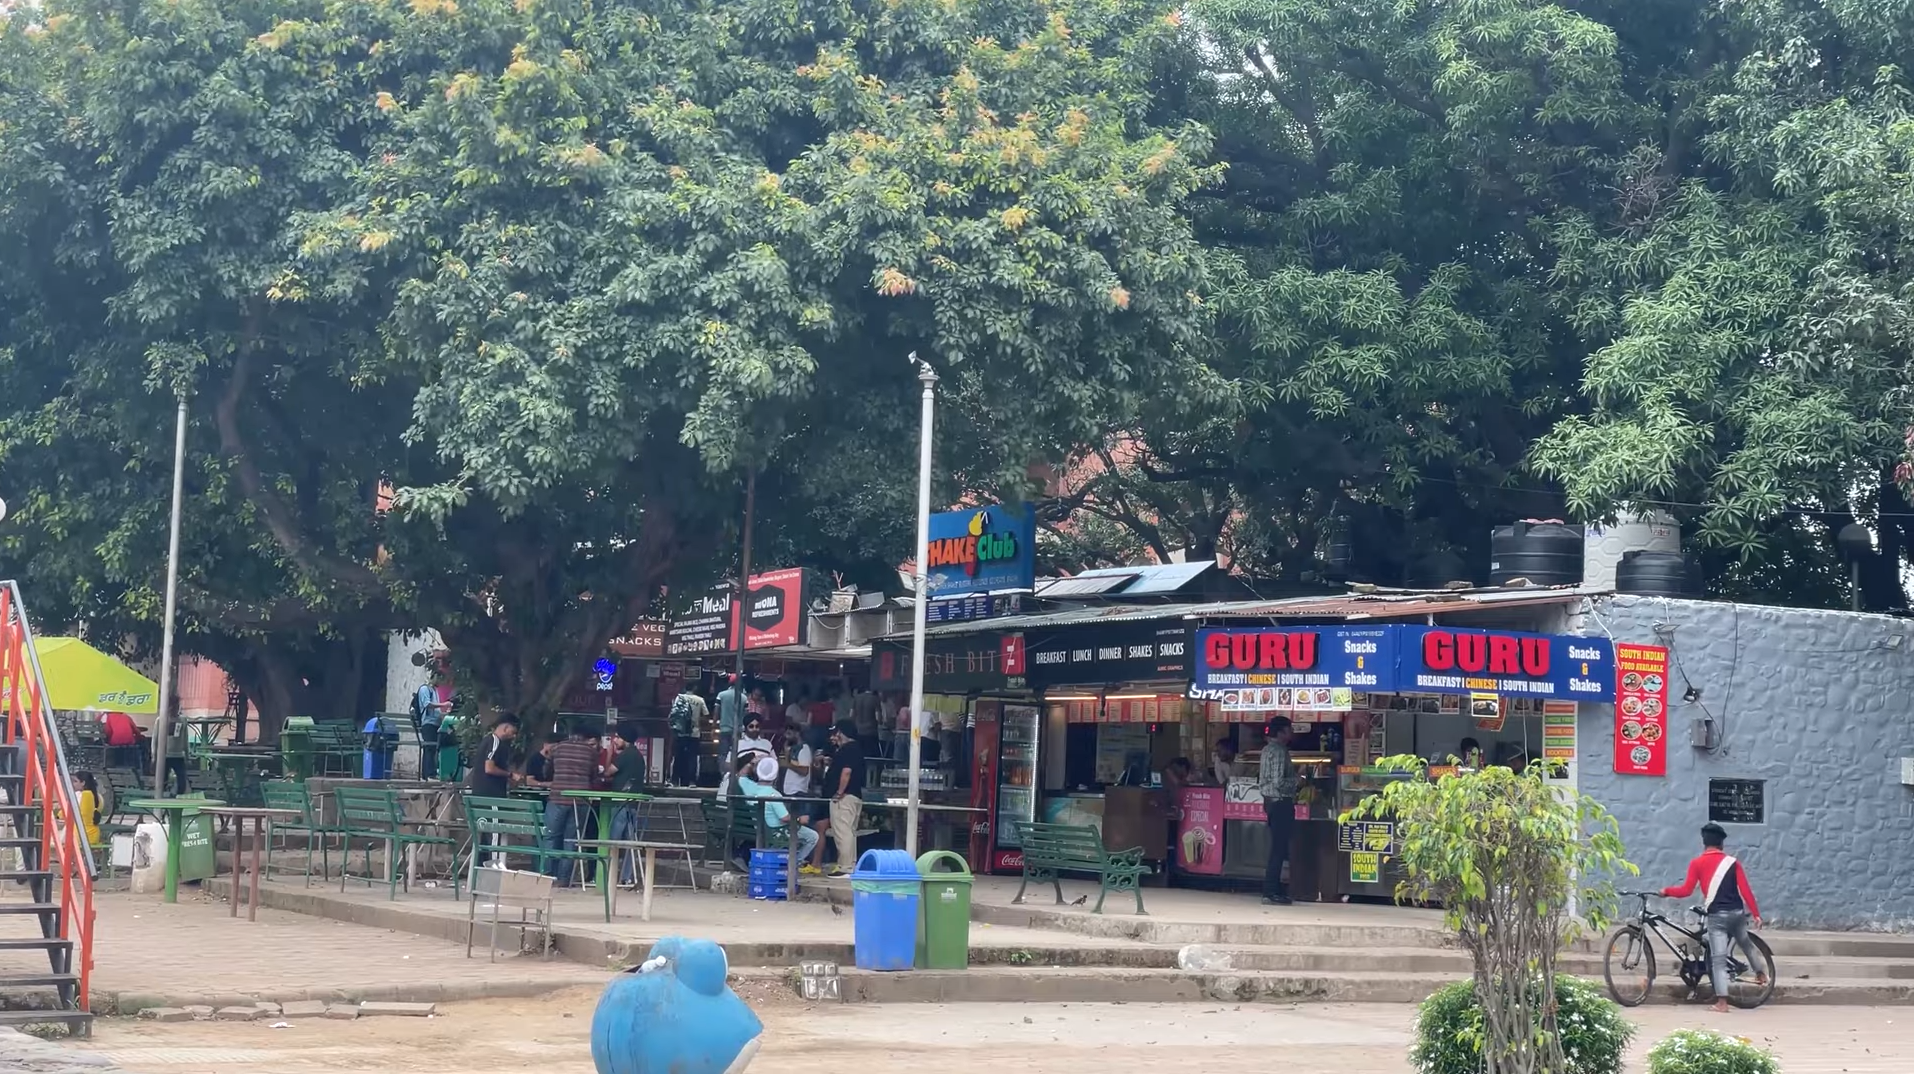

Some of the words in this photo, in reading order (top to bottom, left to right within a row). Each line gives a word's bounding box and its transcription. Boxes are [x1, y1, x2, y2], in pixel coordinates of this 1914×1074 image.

[977, 532, 1015, 561] Club
[702, 593, 730, 614] Meal
[642, 624, 666, 633] VEG
[1204, 631, 1317, 670] GURU
[1344, 639, 1377, 653] Snacks
[1568, 645, 1601, 660] Snacks
[1036, 651, 1067, 664] BREAKFAST
[1072, 649, 1092, 662] LUNCH
[1099, 647, 1122, 660] DINNER
[1129, 645, 1153, 658] SHAKES
[1159, 643, 1184, 656] SNACKS
[1423, 631, 1550, 676] GURU
[1619, 648, 1641, 659] SOUTH
[1643, 650, 1665, 662] INDIAN
[901, 652, 955, 676] FESH
[1621, 661, 1635, 671] FOOD
[1635, 663, 1664, 673] AVAILABLE
[1207, 674, 1244, 685] BREAKFAST
[1248, 674, 1276, 685] CHINESE
[1281, 674, 1304, 685] SOUTH
[1305, 674, 1329, 685] INDIAN
[1344, 671, 1377, 685] Shakes
[1417, 675, 1462, 688] BREAKFAST
[1465, 677, 1498, 691] CHINESE
[1503, 681, 1528, 692] SOUTH
[1529, 681, 1554, 694] INDIAN
[1569, 678, 1602, 692] Shakes
[1431, 767, 1457, 776] SHAKES
[186, 832, 200, 840] WET
[1352, 853, 1377, 864] SOUTH
[1352, 864, 1377, 873] INDIAN
